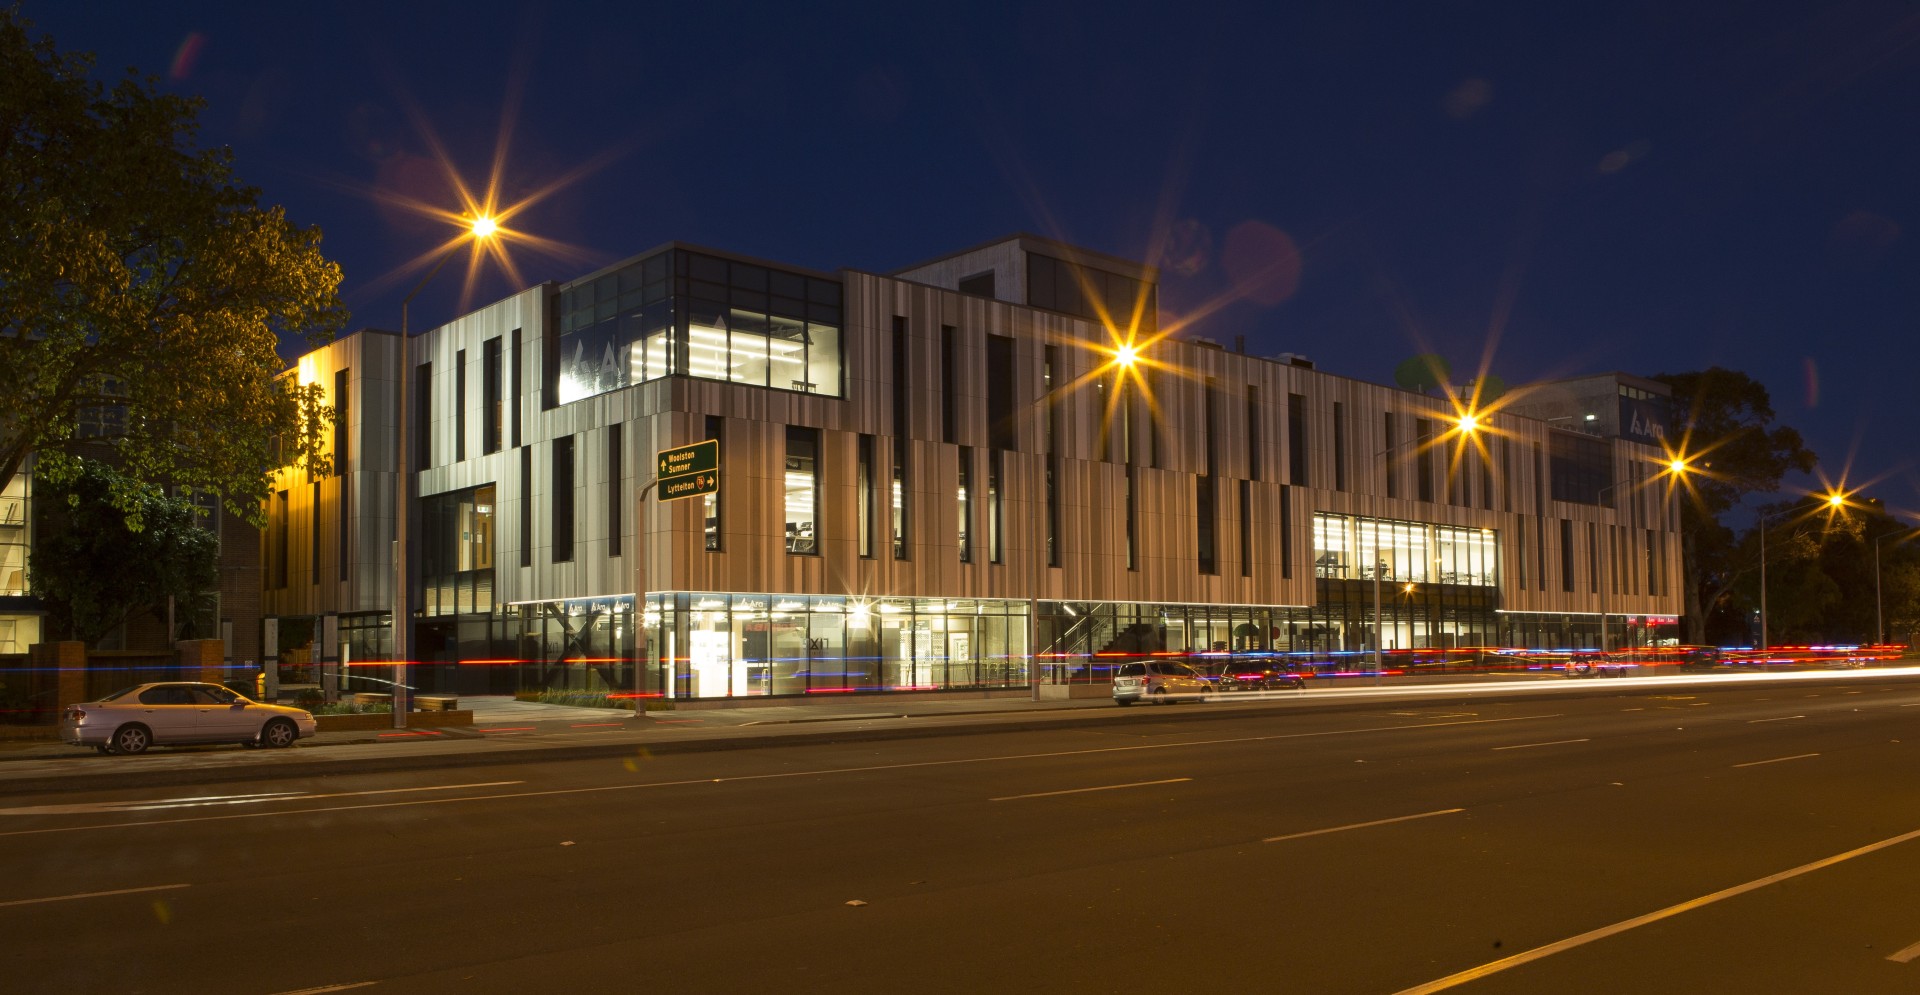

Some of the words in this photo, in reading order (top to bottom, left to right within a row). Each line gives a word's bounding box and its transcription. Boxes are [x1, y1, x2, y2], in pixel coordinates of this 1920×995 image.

[1643, 418, 1663, 439] Ara
[668, 452, 695, 462] Woolston
[668, 463, 691, 473] Sumner
[667, 482, 695, 494] Lyttelton
[597, 603, 606, 611] Ara
[621, 602, 630, 610] Ara
[749, 600, 764, 608] Ara
